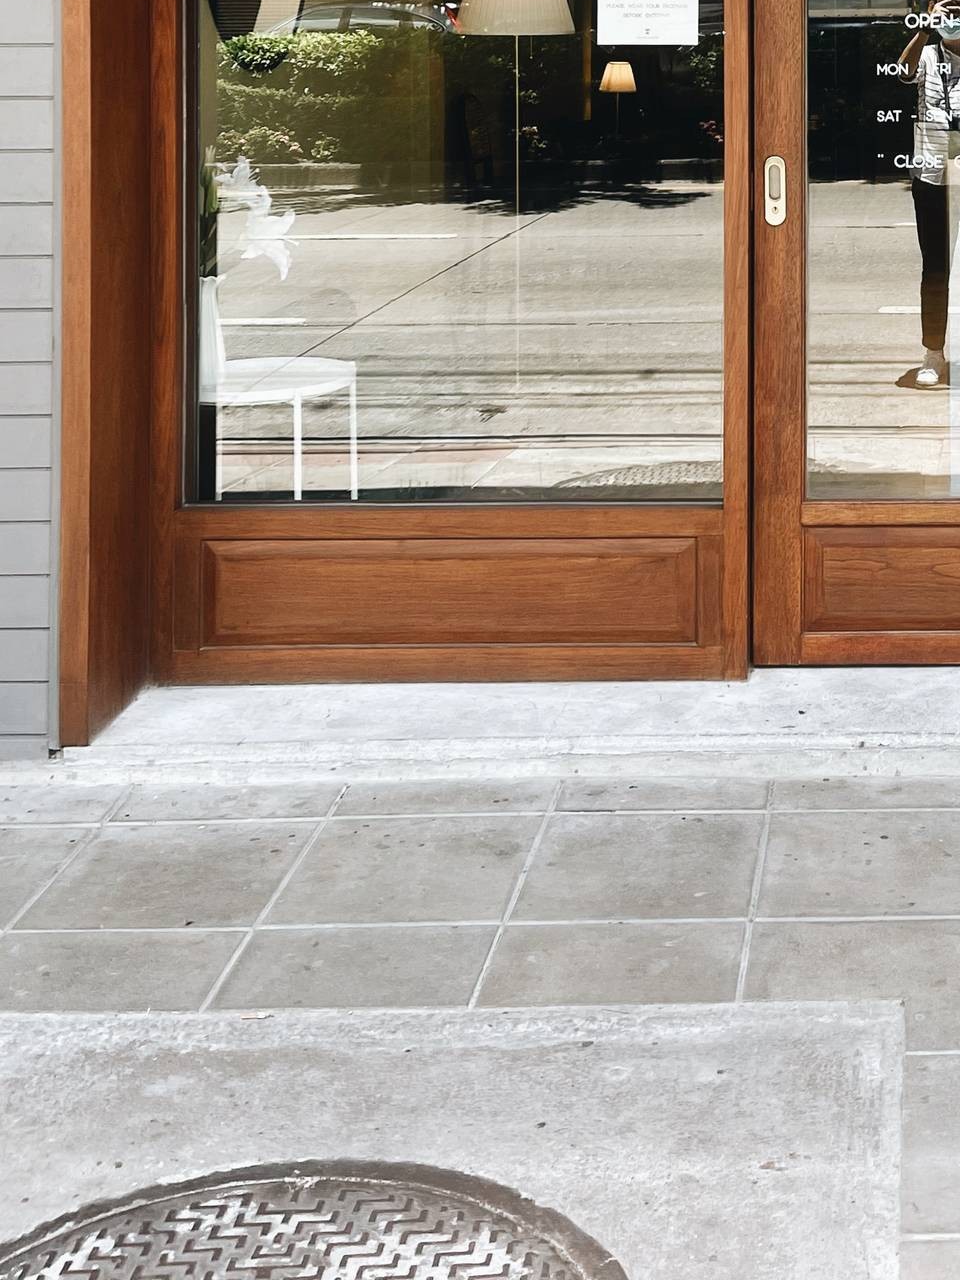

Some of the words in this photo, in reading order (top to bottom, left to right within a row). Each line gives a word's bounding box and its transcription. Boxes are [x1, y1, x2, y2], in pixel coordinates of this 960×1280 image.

[905, 14, 954, 28] OPEN
[876, 63, 909, 76] MON
[876, 110, 902, 122] SAT
[894, 154, 944, 168] CLOSE
